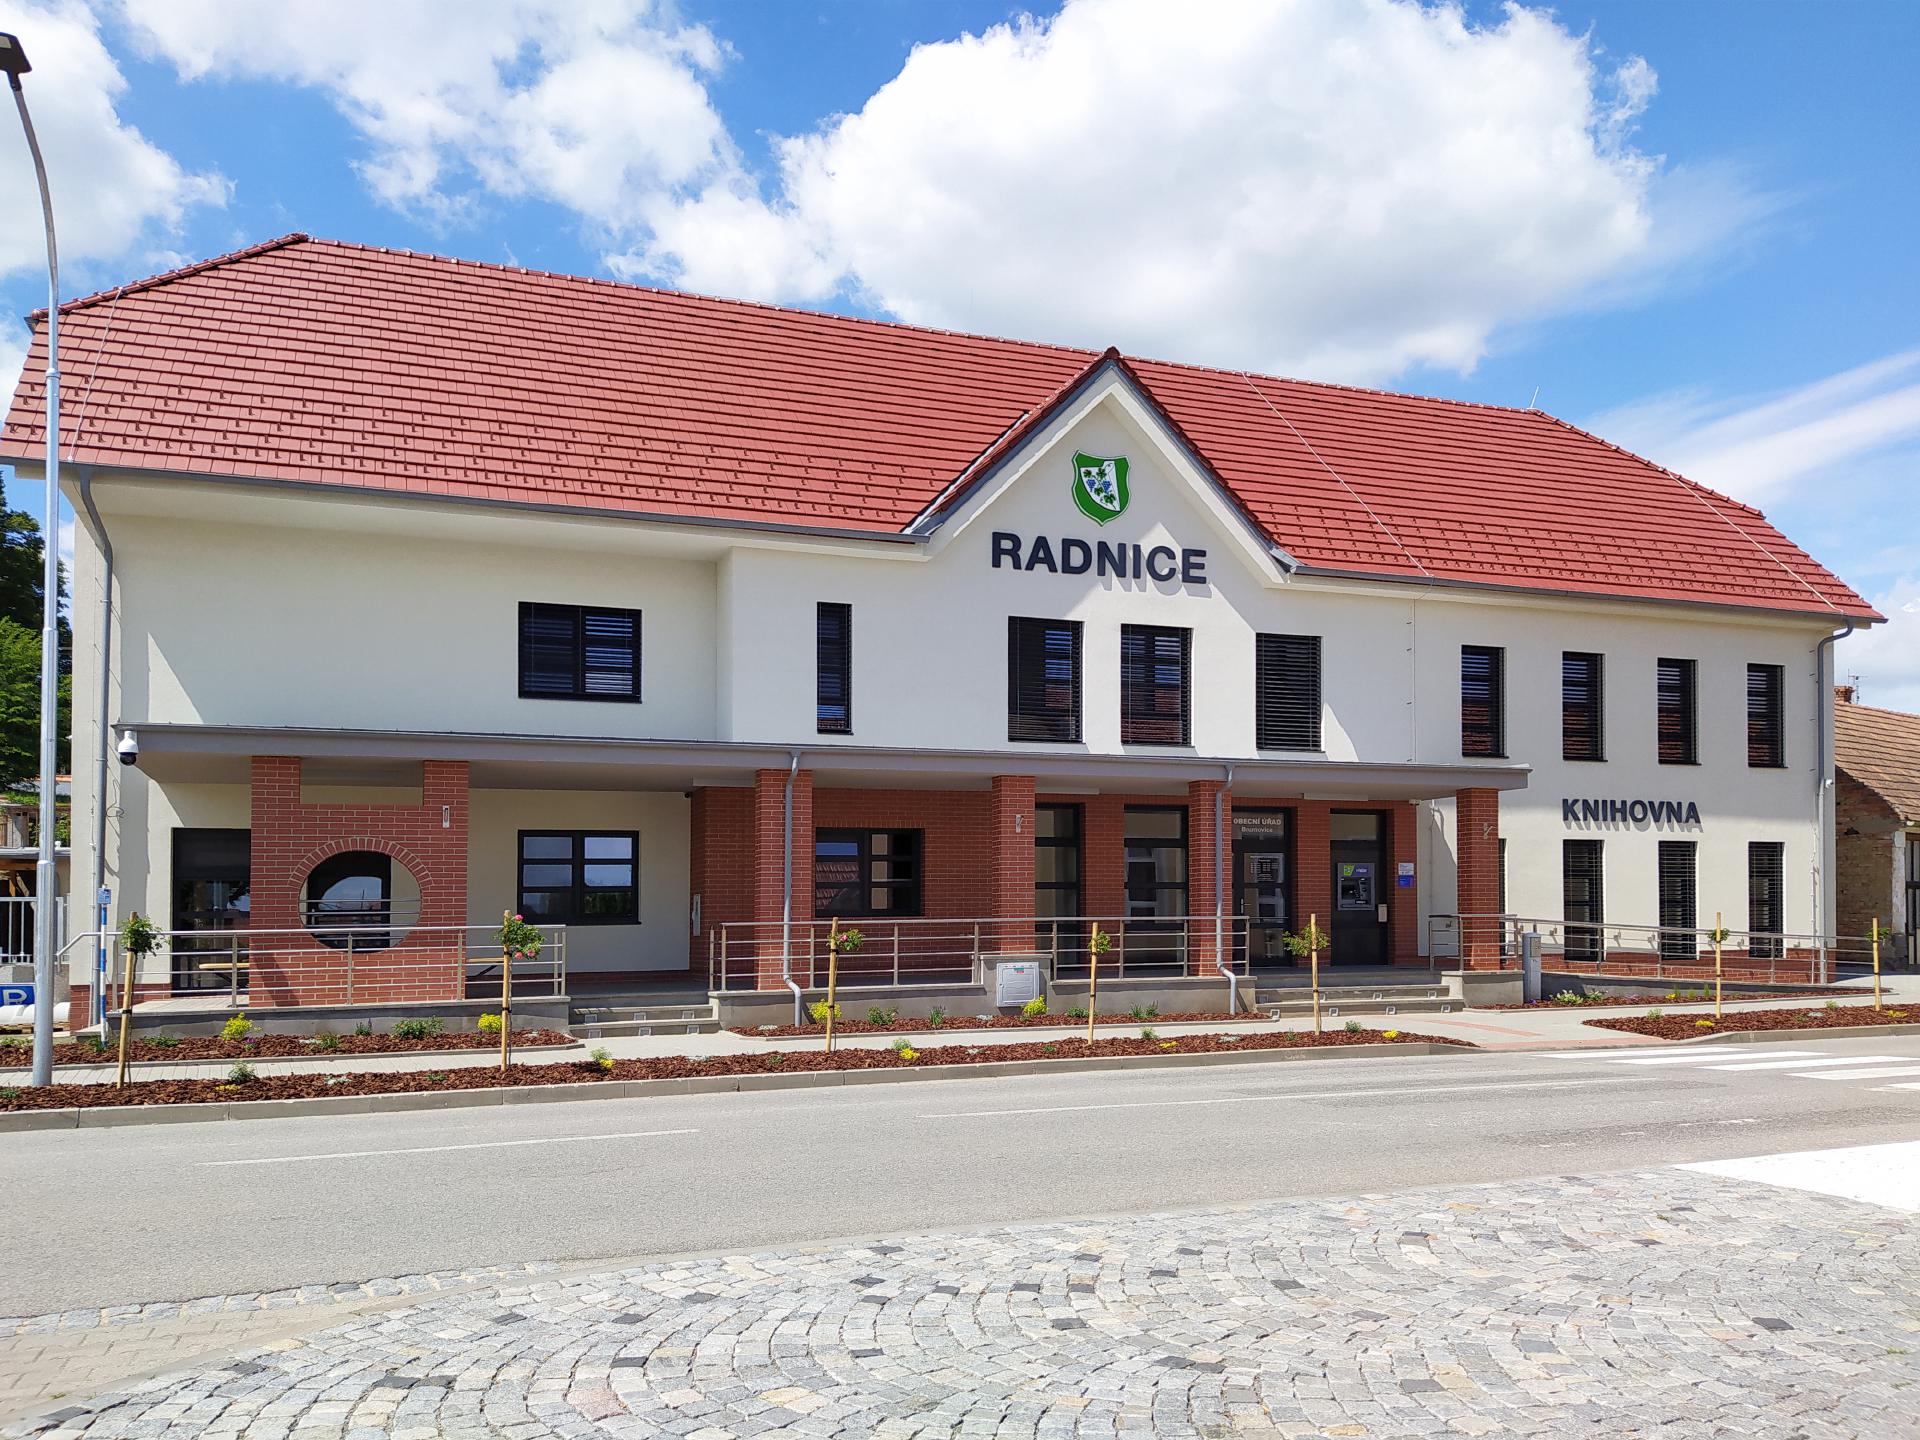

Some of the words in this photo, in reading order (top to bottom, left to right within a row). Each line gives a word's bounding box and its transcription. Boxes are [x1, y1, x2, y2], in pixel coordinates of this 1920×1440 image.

[991, 531, 1207, 585] RADNICE
[1233, 817, 1260, 825] OBECNÍ
[1261, 817, 1282, 825] ÚŘAD
[1562, 798, 1702, 825] KNIHOVNA
